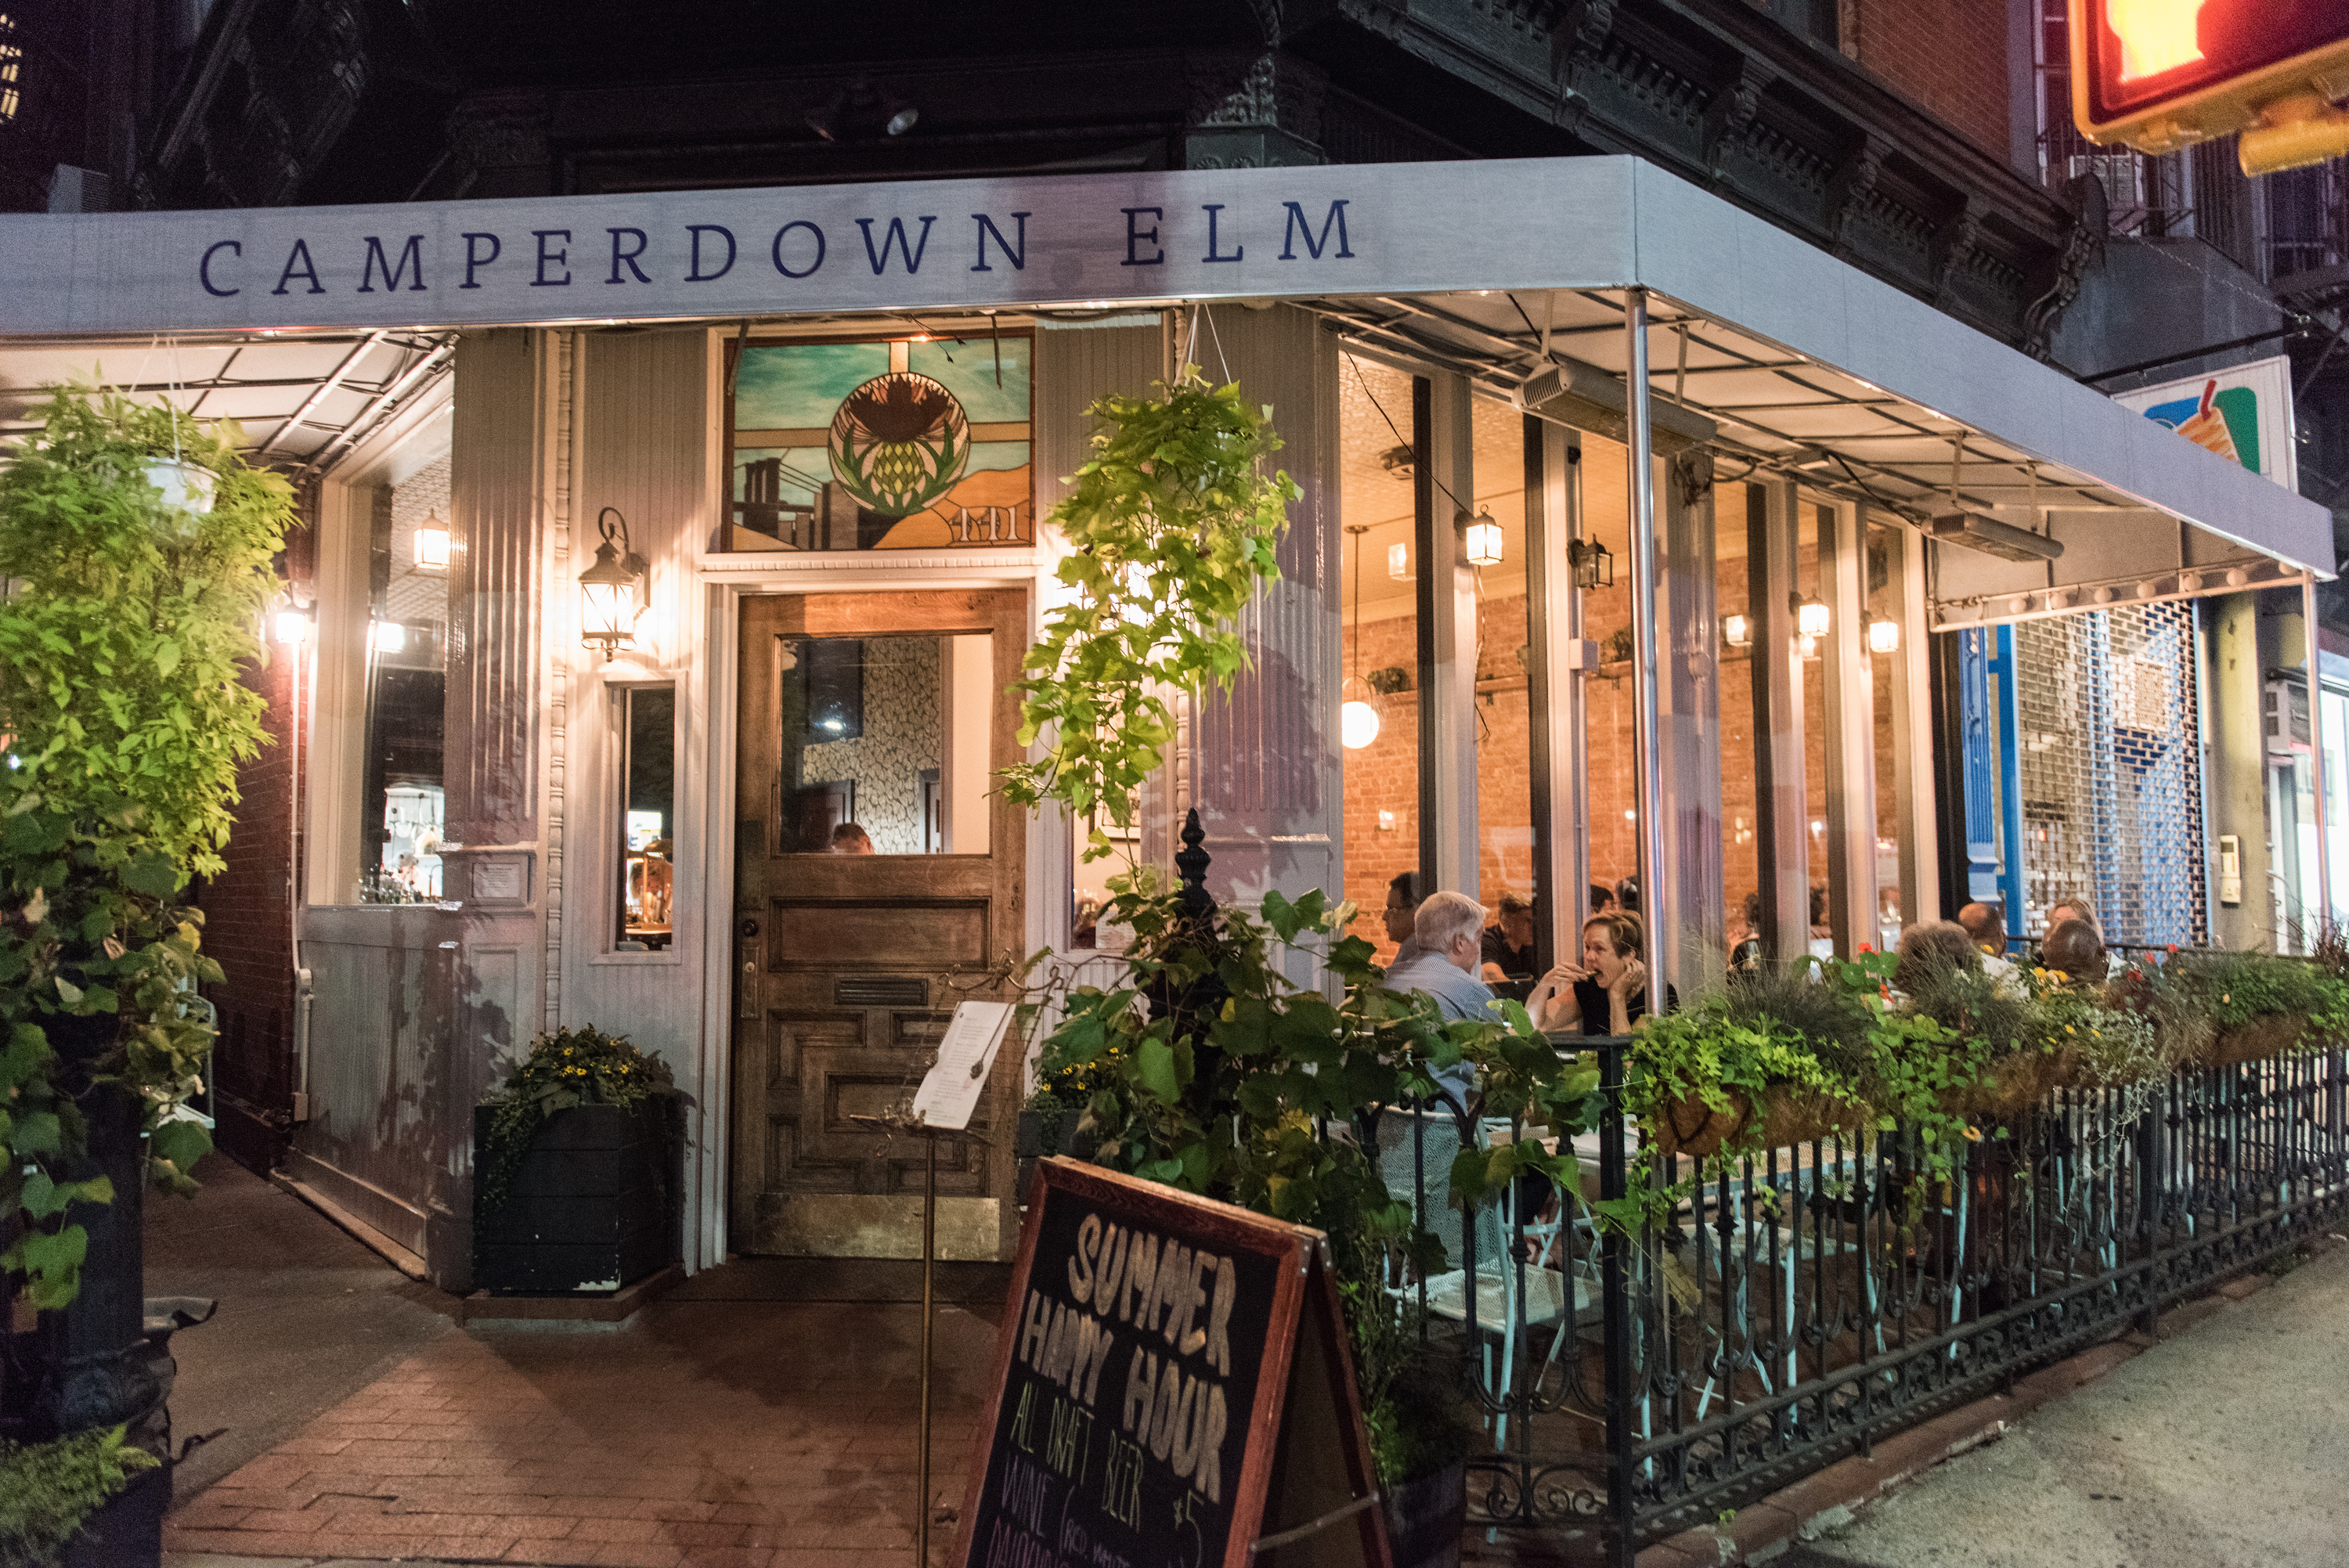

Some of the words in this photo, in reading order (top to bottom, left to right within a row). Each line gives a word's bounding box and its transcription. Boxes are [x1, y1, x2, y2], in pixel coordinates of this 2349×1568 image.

[200, 211, 1032, 297] CAMPERDOWN
[1120, 200, 1355, 266] ELM
[1068, 1213, 1236, 1377] SUMMER
[1010, 1381, 1038, 1454] ALL
[1046, 1396, 1095, 1486] DRAFT
[1101, 1429, 1144, 1534] BEER
[1019, 1289, 1113, 1407] HAPPY
[1123, 1344, 1227, 1505] HOUR
[1001, 1451, 1054, 1538] WINE
